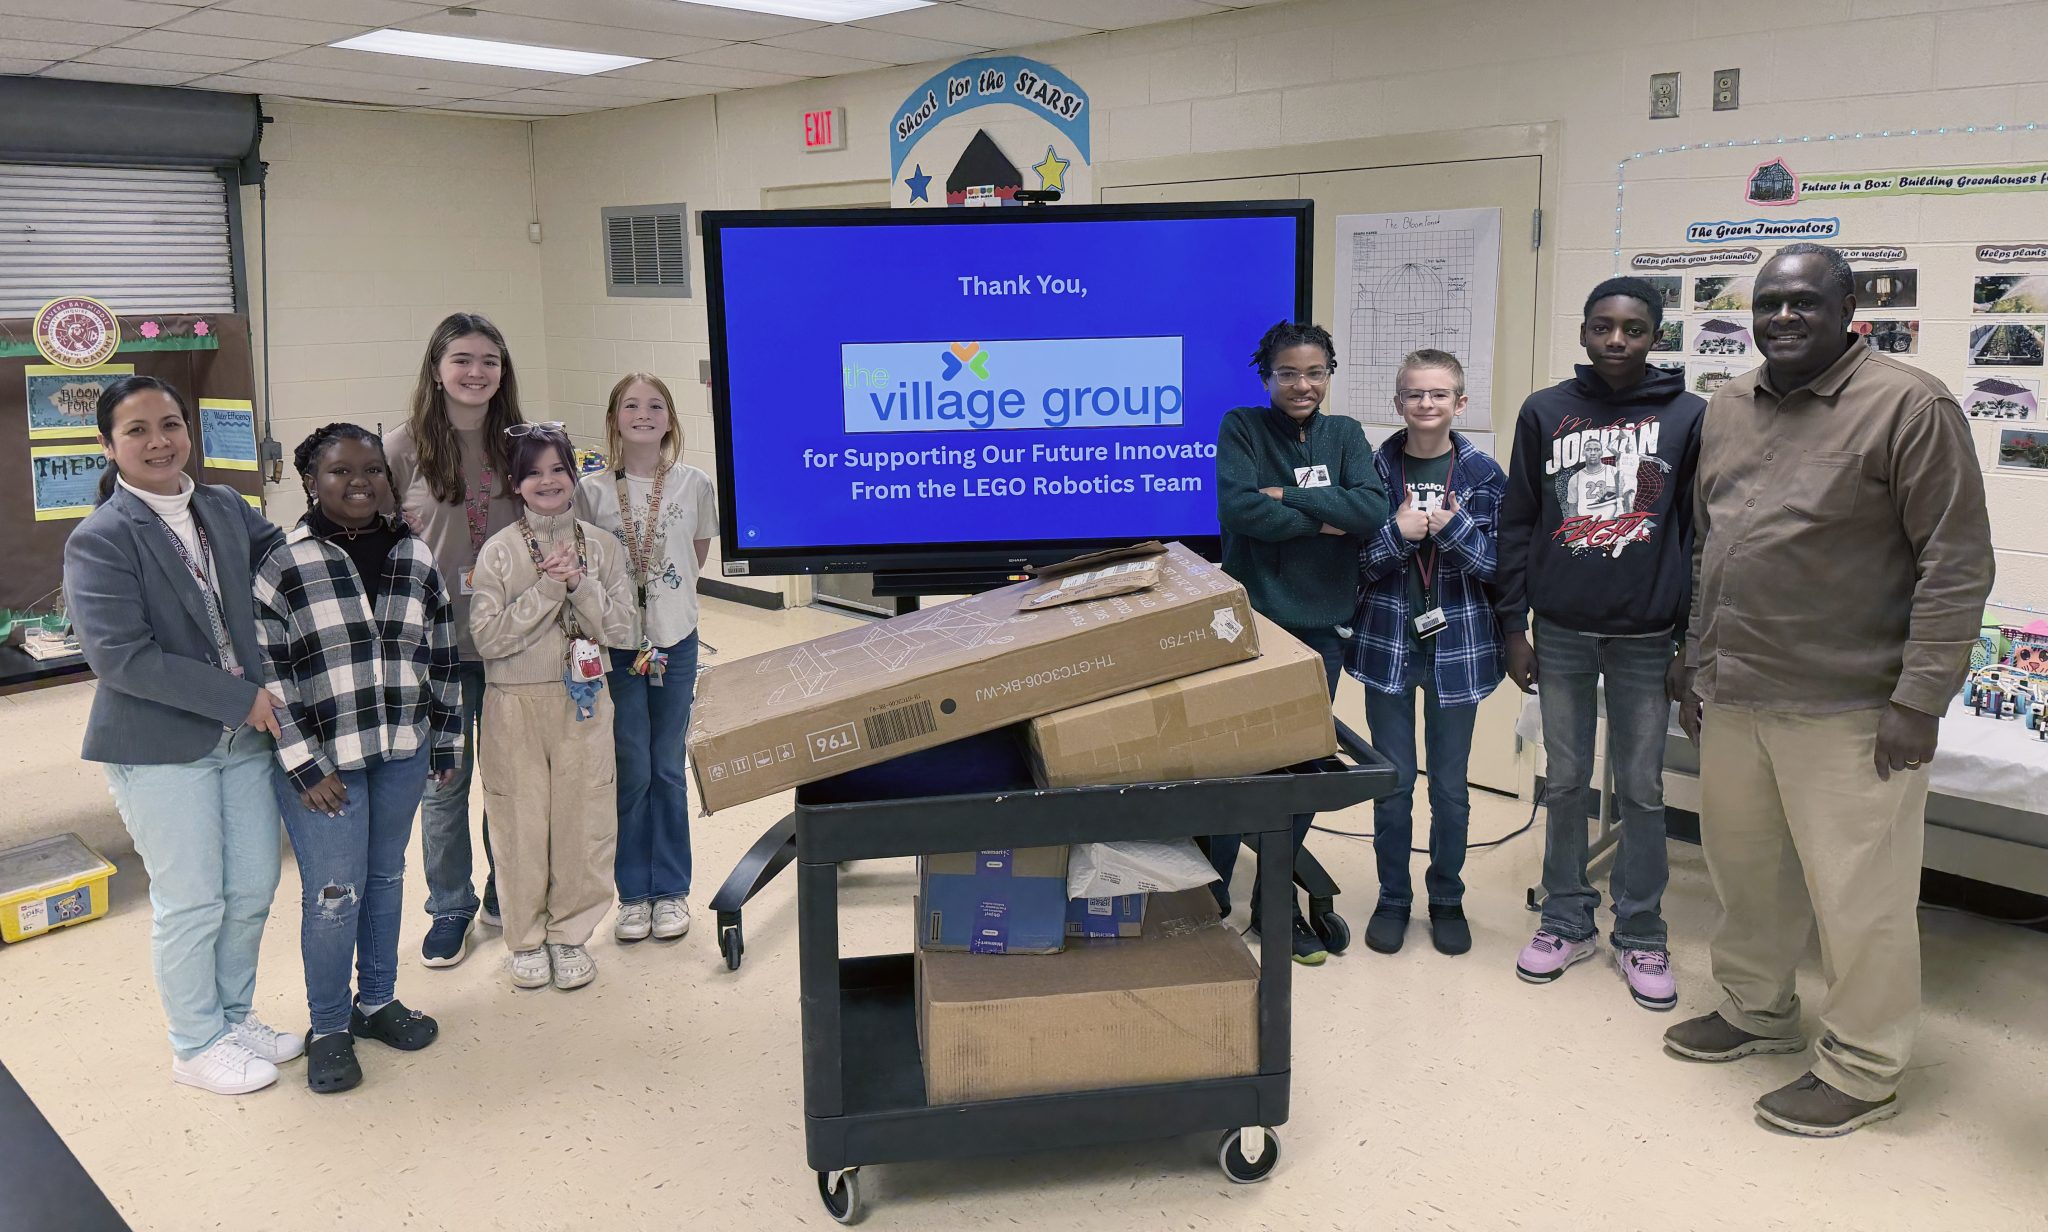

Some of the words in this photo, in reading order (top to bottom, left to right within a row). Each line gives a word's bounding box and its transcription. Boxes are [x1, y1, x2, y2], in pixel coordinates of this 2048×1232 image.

[898, 92, 937, 140] Shoot
[949, 79, 971, 105] for
[979, 70, 1004, 93] the
[1016, 73, 1083, 121] STARS!
[804, 110, 832, 147] EXIT
[1801, 181, 1837, 193] Future
[1840, 181, 1850, 191] in
[1865, 179, 1892, 190] Box:
[1899, 176, 1954, 188] Building
[1957, 174, 2037, 188] Greenhouses
[1691, 226, 1712, 238] The
[1716, 224, 1751, 239] Green
[1755, 222, 1834, 235] Innovators
[1635, 257, 1660, 265] Helps
[1660, 257, 1686, 265] plants
[1709, 252, 1757, 261] sustainably
[1861, 249, 1903, 259] wasteful
[1980, 249, 2011, 259] Helps
[2012, 248, 2047, 258] plants
[957, 274, 1031, 296] Thank
[1036, 274, 1088, 298] You,
[42, 340, 71, 363] STEAM
[75, 336, 113, 364] ACADEMY
[844, 362, 889, 389] the
[60, 388, 100, 402] BLOOM
[869, 380, 1026, 429] village
[1042, 383, 1182, 427] group
[227, 411, 251, 422] Efficiency
[803, 448, 838, 468] for
[844, 445, 977, 472] Supporting
[982, 444, 1025, 464] Our
[1032, 443, 1108, 463] Future
[1115, 441, 1218, 460] Innovato
[1545, 421, 1660, 475] JORDAN
[85, 455, 108, 470] DO
[852, 481, 911, 500] From
[917, 478, 956, 498] the
[963, 477, 1026, 498] LEGO
[1034, 474, 1135, 496] Robotics
[1140, 473, 1202, 493] Team
[1417, 482, 1446, 492] CAROL
[1551, 511, 1660, 546] FLIGHT
[1159, 628, 1206, 650] HJ-750
[975, 654, 1116, 703] TH-GTC3C06-BK-WJ
[816, 731, 853, 753] T96
